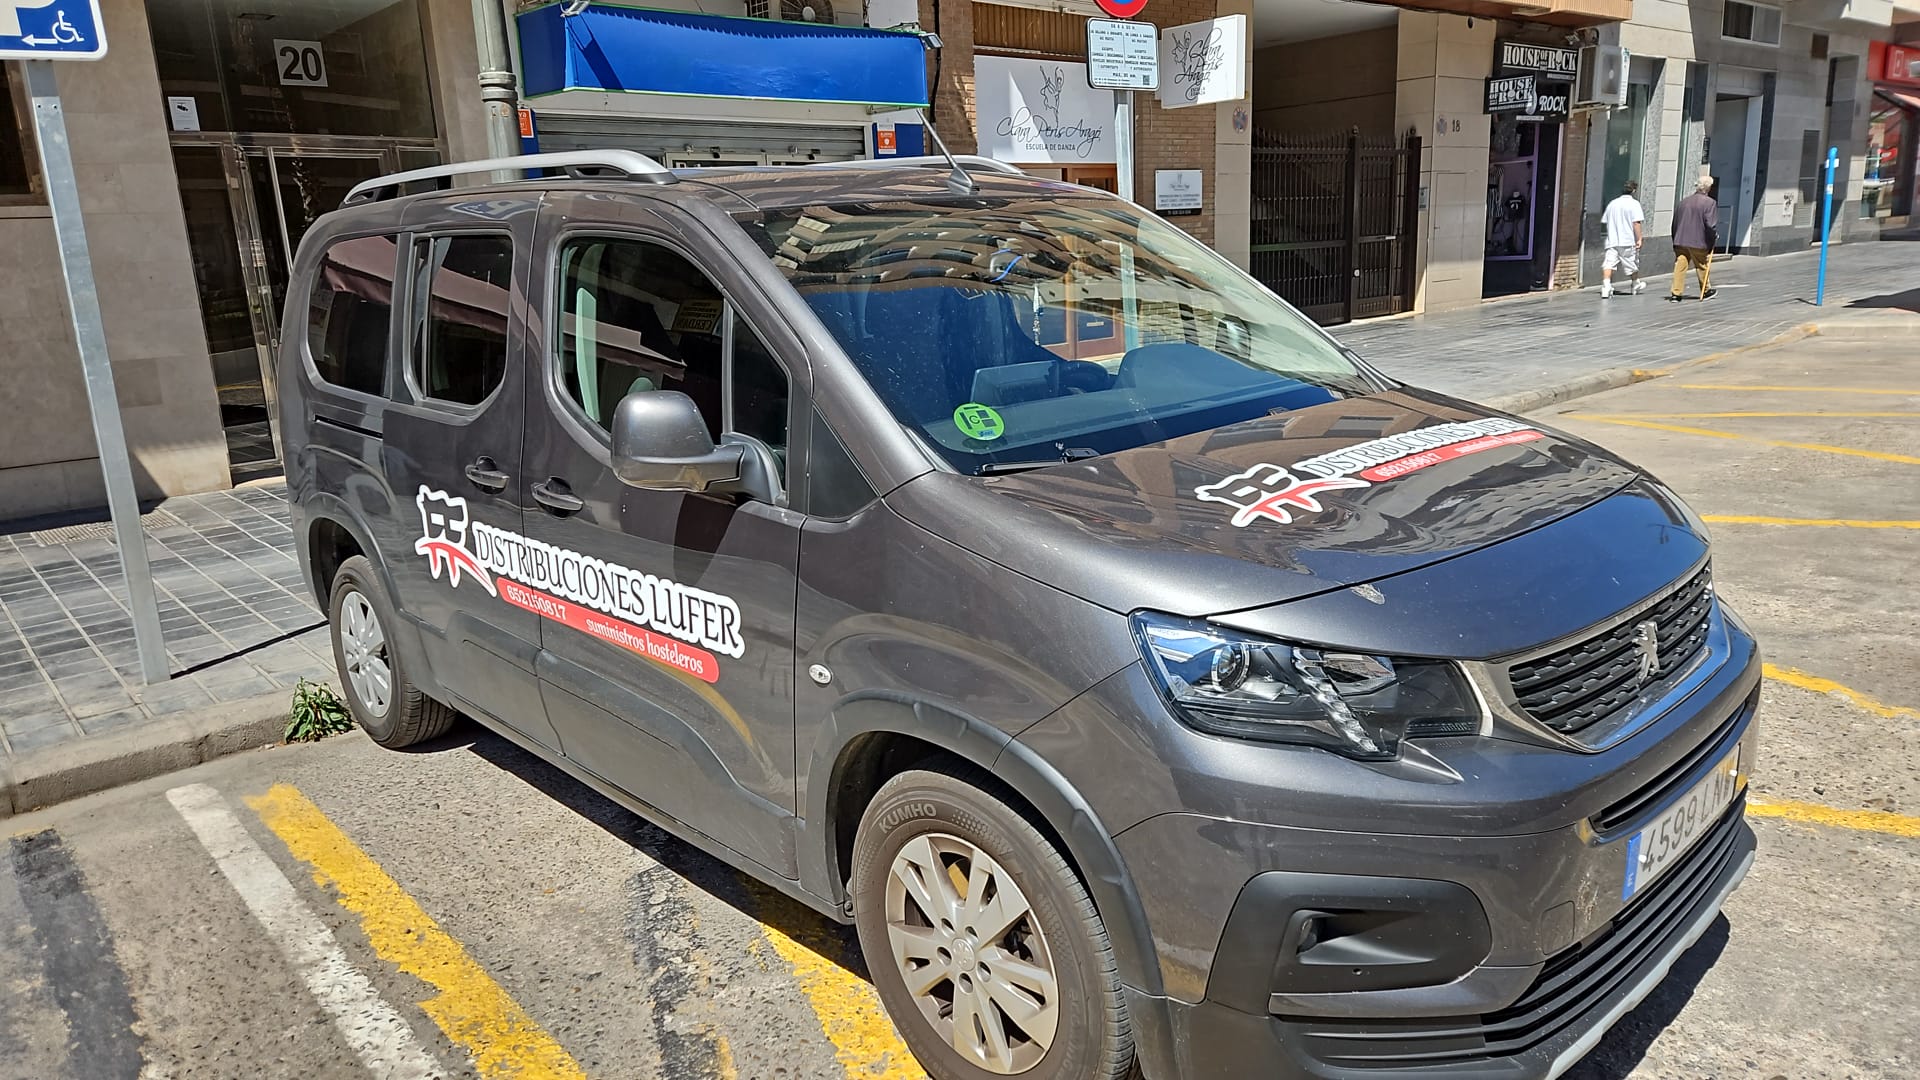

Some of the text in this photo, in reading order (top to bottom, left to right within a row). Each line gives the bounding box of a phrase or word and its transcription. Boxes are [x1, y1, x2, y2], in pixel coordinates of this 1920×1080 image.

[280, 46, 322, 81] 20
[1503, 45, 1540, 68] HOUSE
[1540, 50, 1548, 60] OF
[1490, 78, 1533, 93] HOUSE
[1540, 95, 1567, 114] ROCK
[997, 106, 1037, 142] Clara
[1033, 115, 1066, 138] Peris
[1452, 119, 1461, 132] 18
[1025, 143, 1048, 151] ESCUELA
[969, 415, 980, 424] C
[1303, 424, 1476, 477] DISTRIBUCIONES
[476, 528, 739, 648] DISTRIBUCIONES LUFER
[507, 584, 704, 674] 652150817 suministros hosteleros
[879, 803, 937, 833] KUMHO
[1642, 795, 1698, 873] 4599
